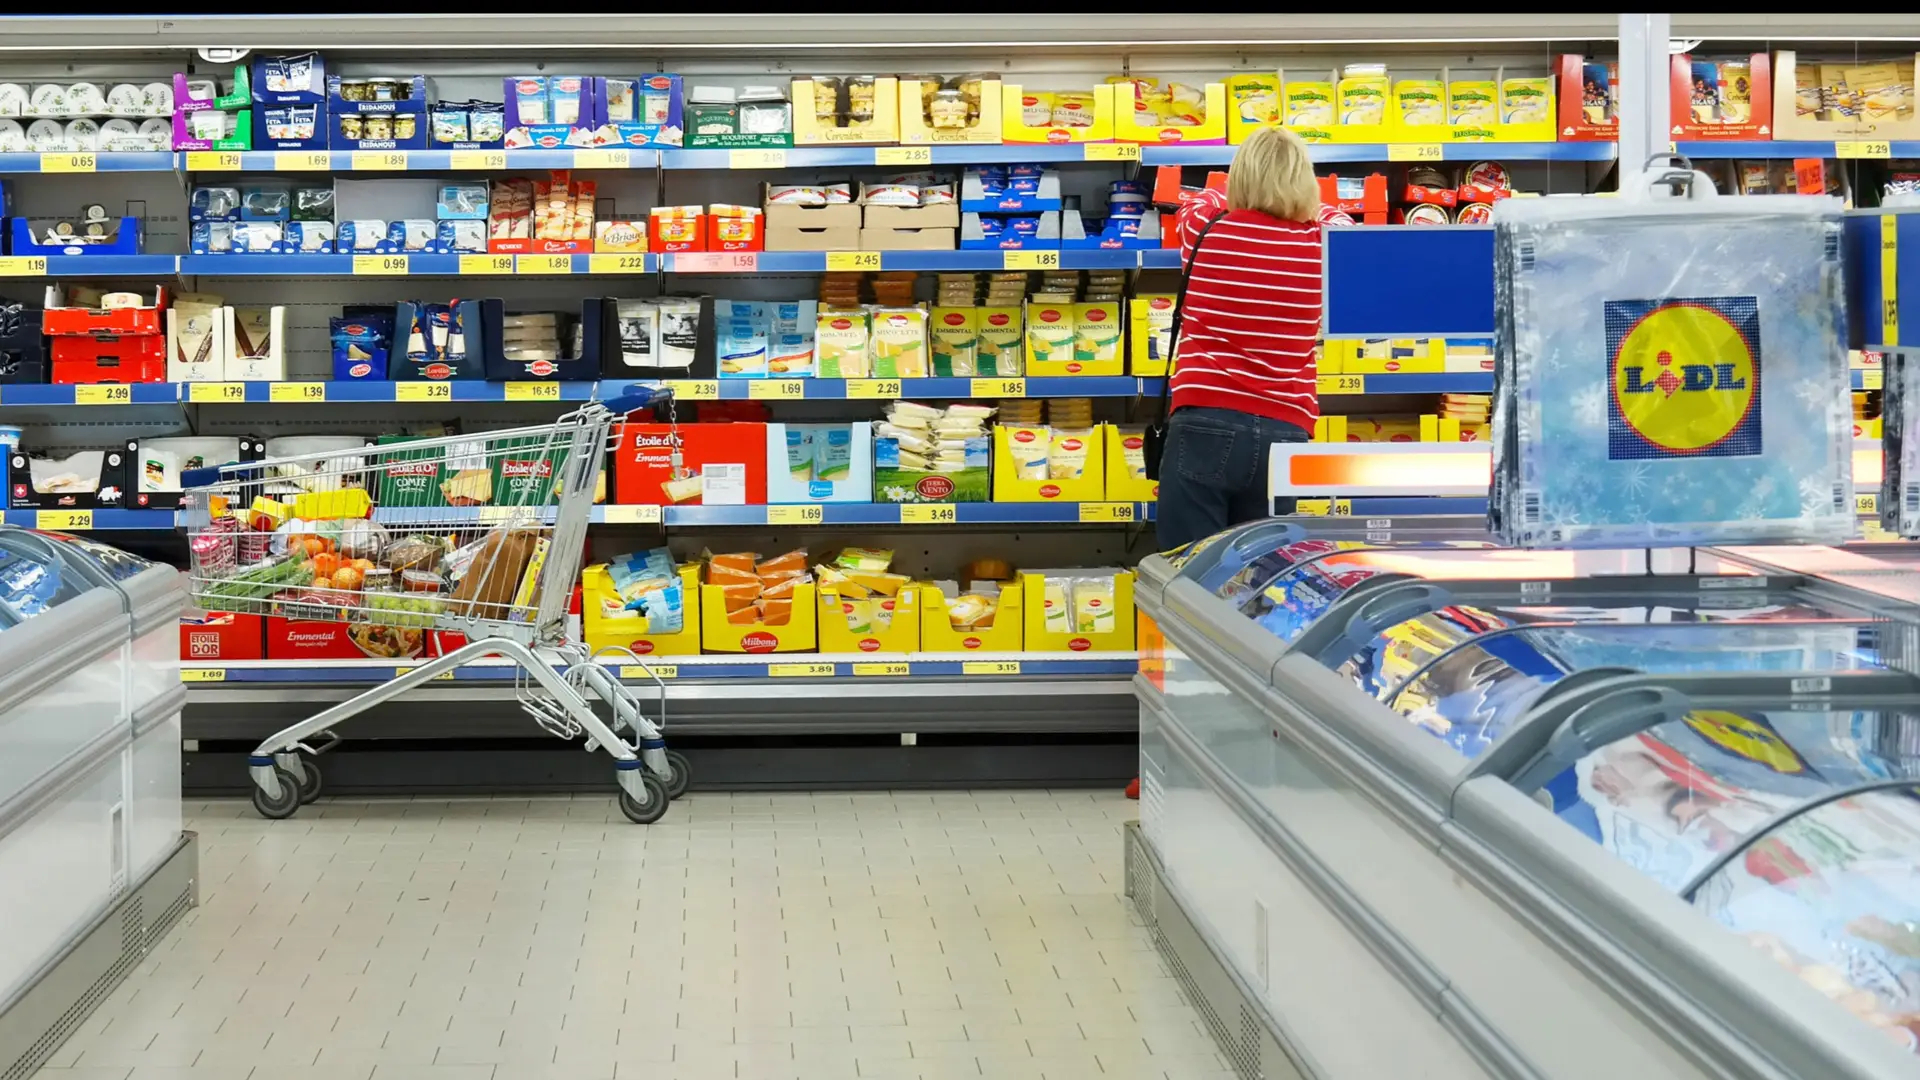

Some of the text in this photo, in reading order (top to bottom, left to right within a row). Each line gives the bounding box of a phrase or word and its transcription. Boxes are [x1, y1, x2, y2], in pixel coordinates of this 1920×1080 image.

[905, 150, 928, 160] 2.85
[1117, 147, 1137, 157] 2.19
[1418, 147, 1441, 157] 2.66
[1866, 144, 1888, 155] 2.29
[71, 156, 94, 167] 0.65
[219, 155, 240, 166] 1.79
[307, 155, 328, 166] 1.69
[384, 155, 405, 165] 1.89
[484, 154, 504, 166] 1.29
[383, 258, 406, 269] 0.99
[492, 258, 512, 269] 1.99
[548, 257, 569, 268] 1.89
[620, 257, 642, 268] 2.22
[733, 256, 754, 266] 1.59
[855, 255, 878, 265] 2.45
[1036, 254, 1057, 264] 1.85
[28, 260, 45, 271] 1.19
[877, 383, 899, 394] 2.29
[1002, 383, 1023, 393] 1.85
[1339, 378, 1361, 389] 2.39
[106, 388, 129, 399] 2.99
[222, 387, 243, 398] 1.79
[303, 386, 323, 397] 1.39
[427, 385, 449, 396] 3.29
[532, 386, 557, 396] 16.45
[694, 384, 716, 395] 2.39
[781, 384, 801, 395] 1.69
[636, 434, 662, 447] Étoile
[635, 452, 671, 463] Emmen
[922, 486, 949, 494] VENTO
[801, 508, 821, 519] 1.69
[931, 509, 953, 520] 3.49
[1112, 507, 1132, 518] 1.99
[68, 516, 90, 527] 2.29
[191, 633, 219, 643] ETOILE
[287, 631, 335, 642] Emmental
[741, 637, 776, 648] Milbona
[655, 667, 675, 675] 1.39
[808, 665, 832, 673] 3.89
[885, 666, 908, 674] 3.99
[996, 663, 1017, 671] 3.15
